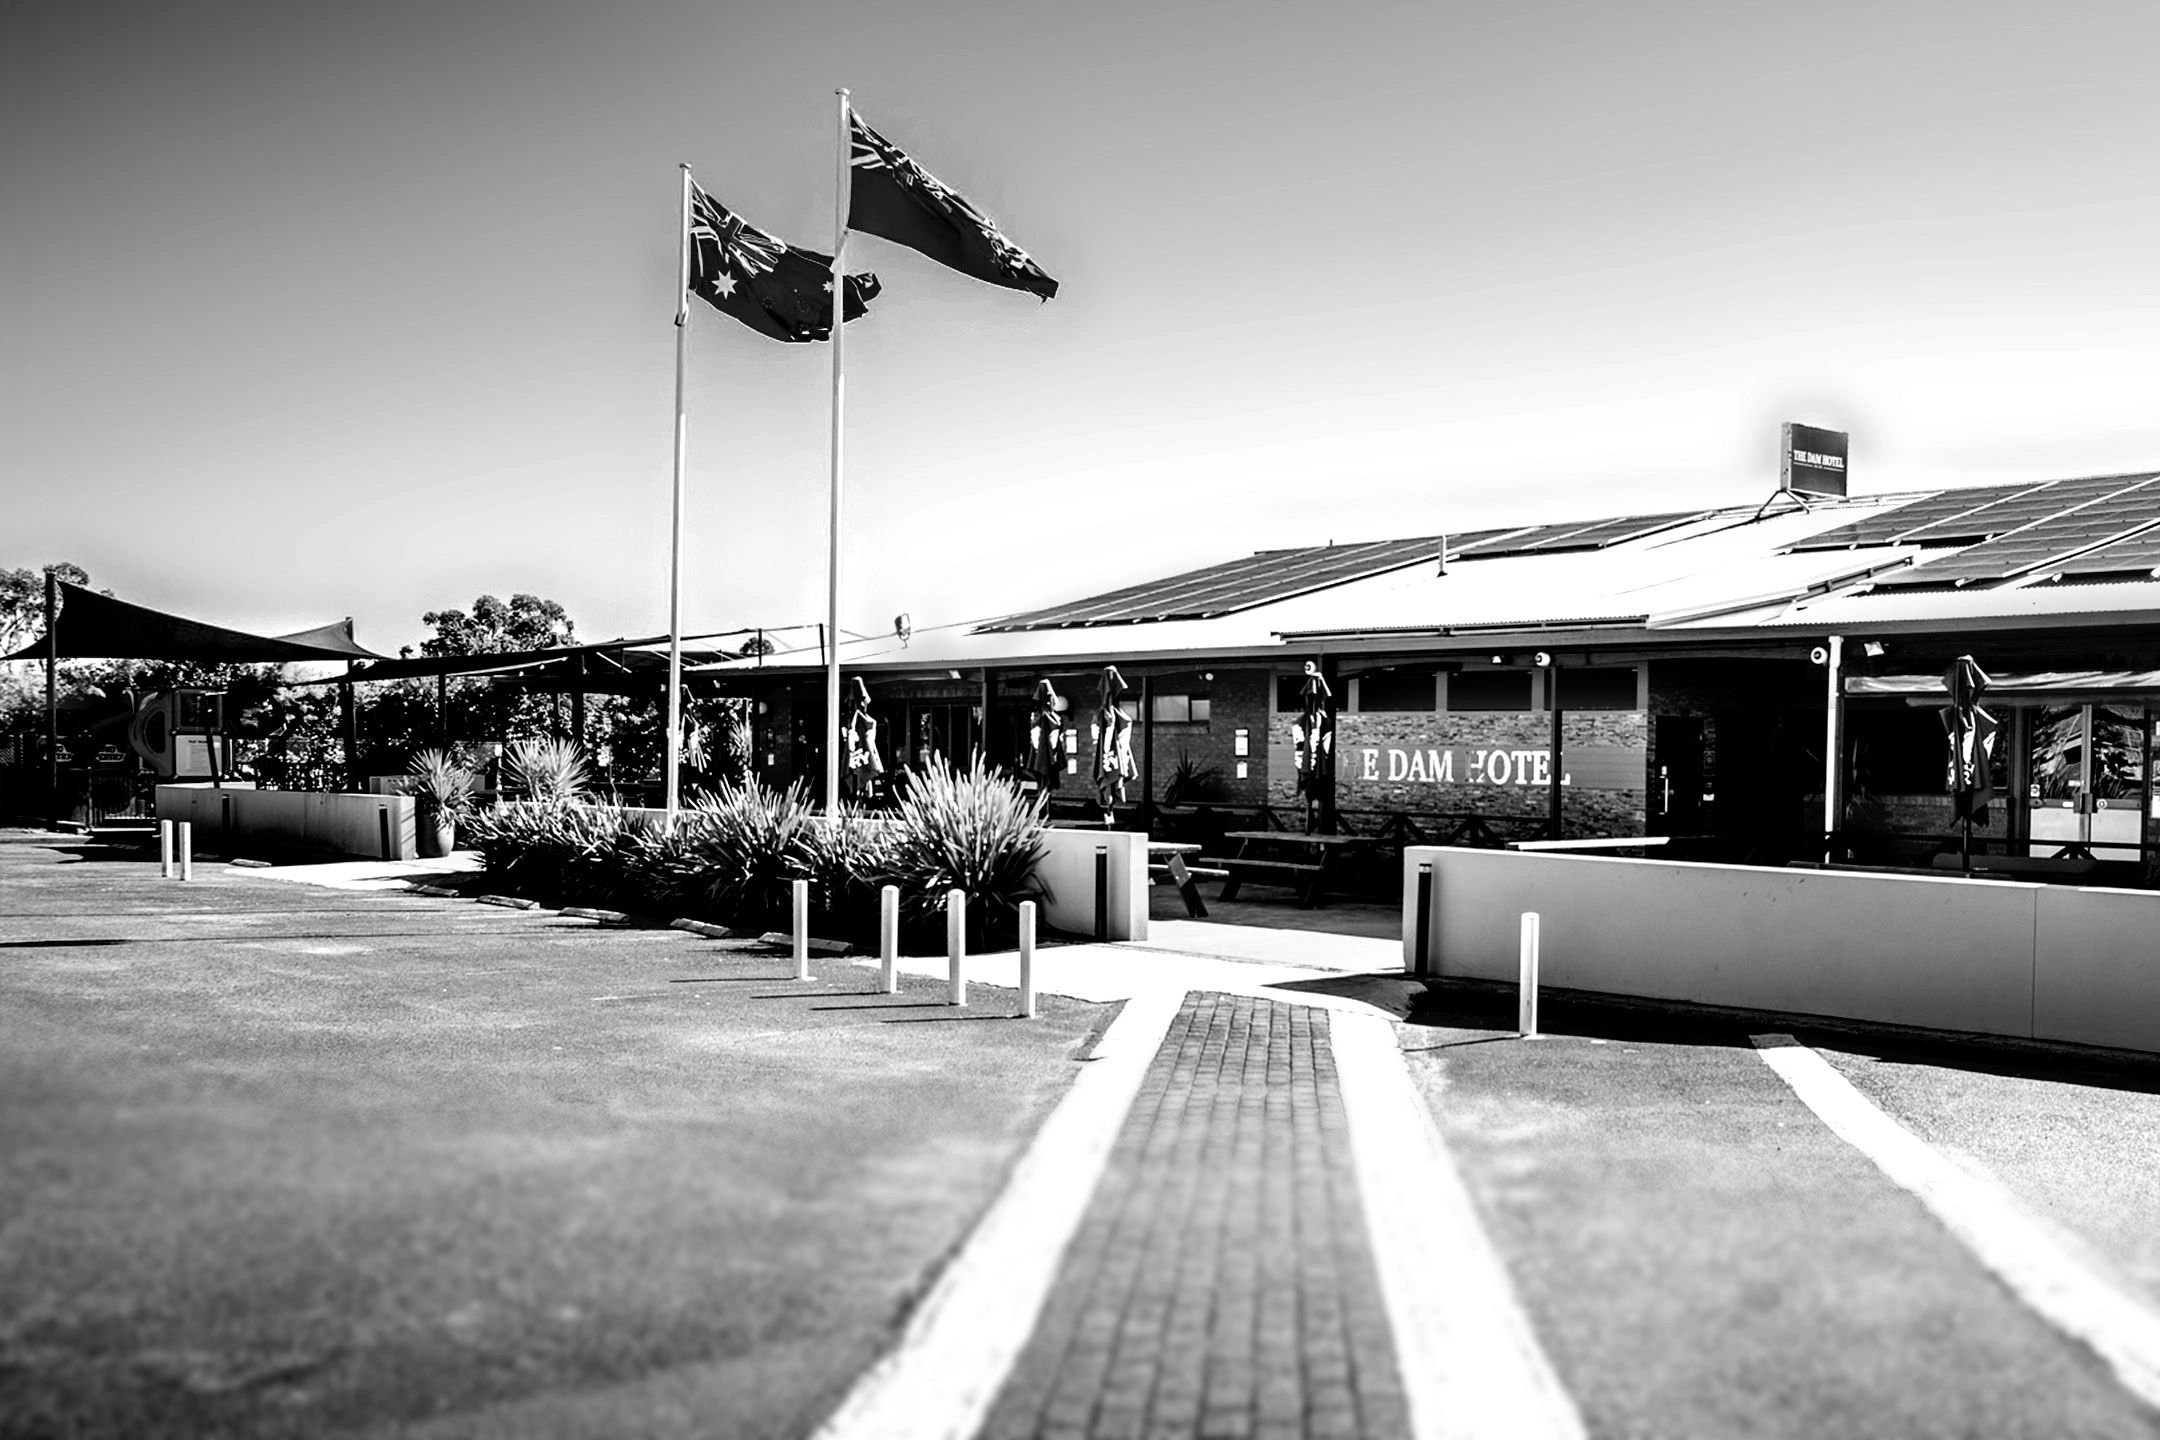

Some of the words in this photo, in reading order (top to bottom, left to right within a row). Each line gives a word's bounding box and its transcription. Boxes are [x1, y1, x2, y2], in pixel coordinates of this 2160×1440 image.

[1793, 449, 1807, 462] THE
[1807, 451, 1822, 465] DAM
[1822, 454, 1845, 468] HOTEL
[1387, 748, 1454, 782] DAM
